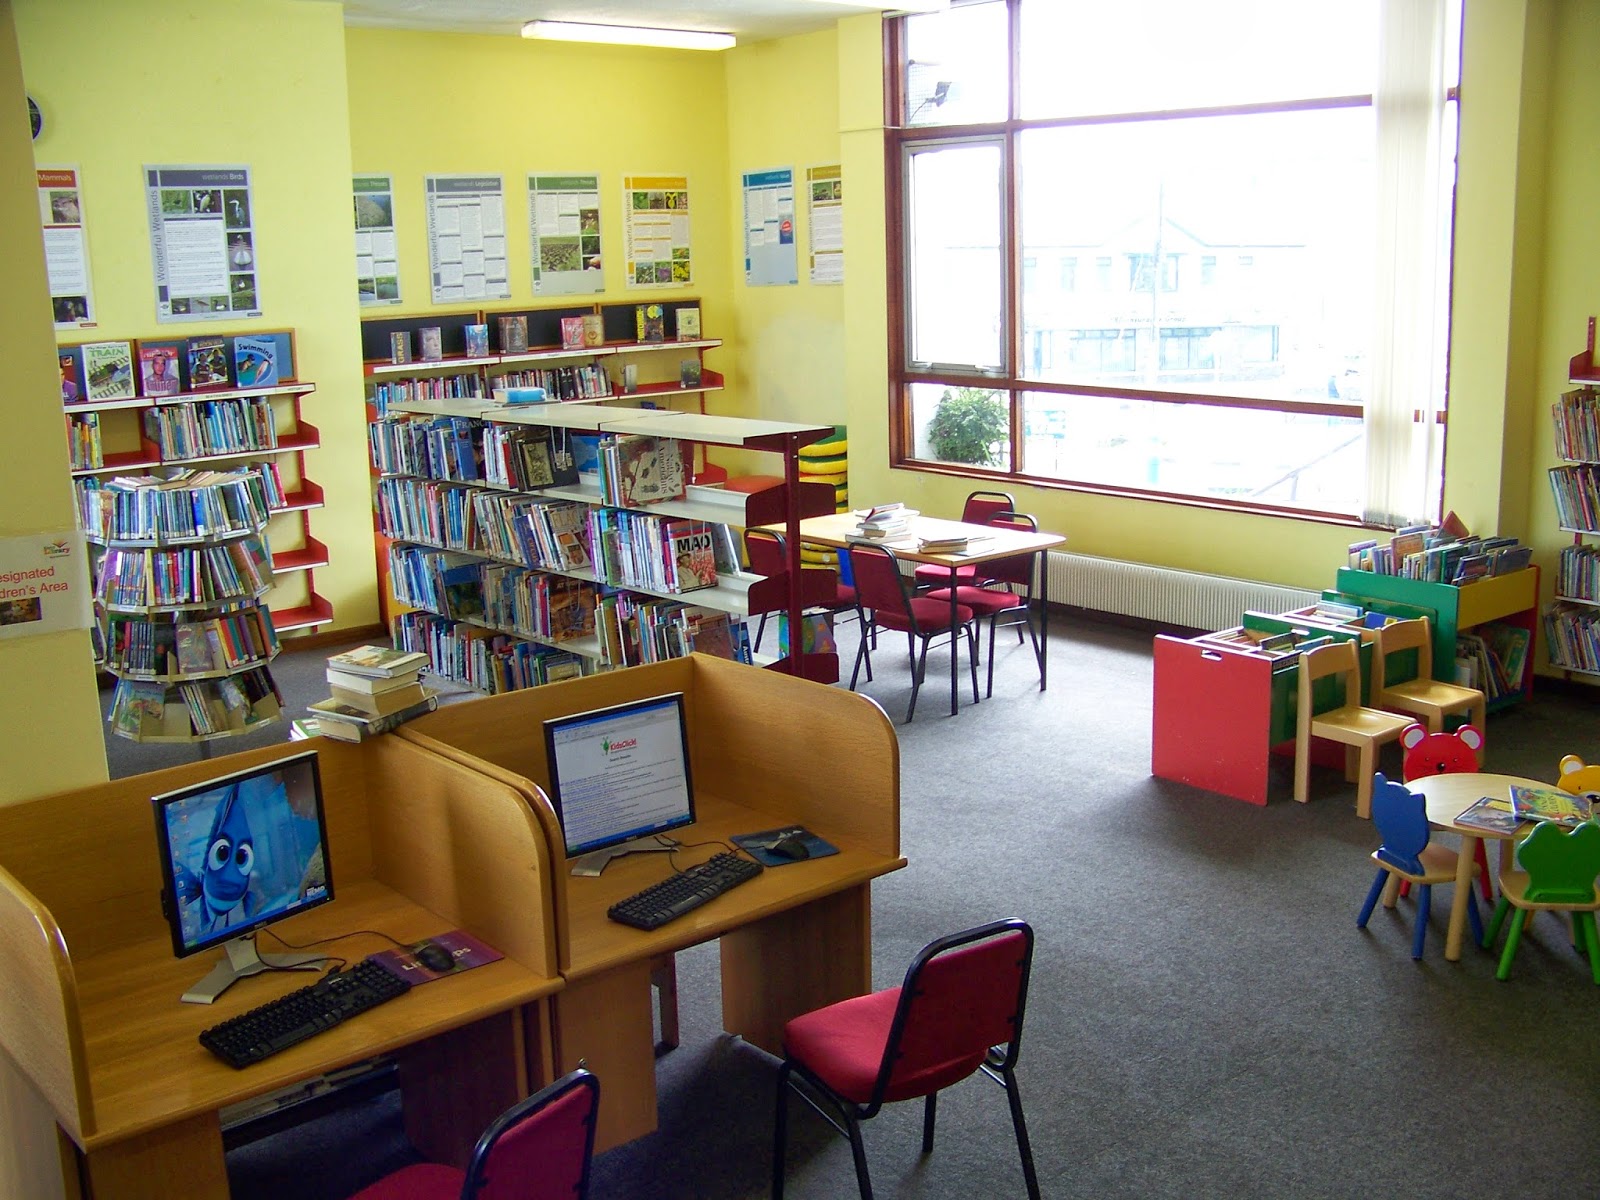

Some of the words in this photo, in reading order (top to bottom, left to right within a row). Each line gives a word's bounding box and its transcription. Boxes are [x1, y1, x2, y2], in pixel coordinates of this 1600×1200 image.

[151, 190, 160, 232] Wetlands
[155, 234, 165, 282] Wonderful
[90, 348, 124, 358] TRAIN
[239, 344, 273, 360] Swimming
[396, 332, 405, 363] GRASS
[659, 447, 668, 494] Americans
[677, 535, 710, 553] MAO
[0, 566, 55, 584] signated
[40, 582, 68, 594] Area
